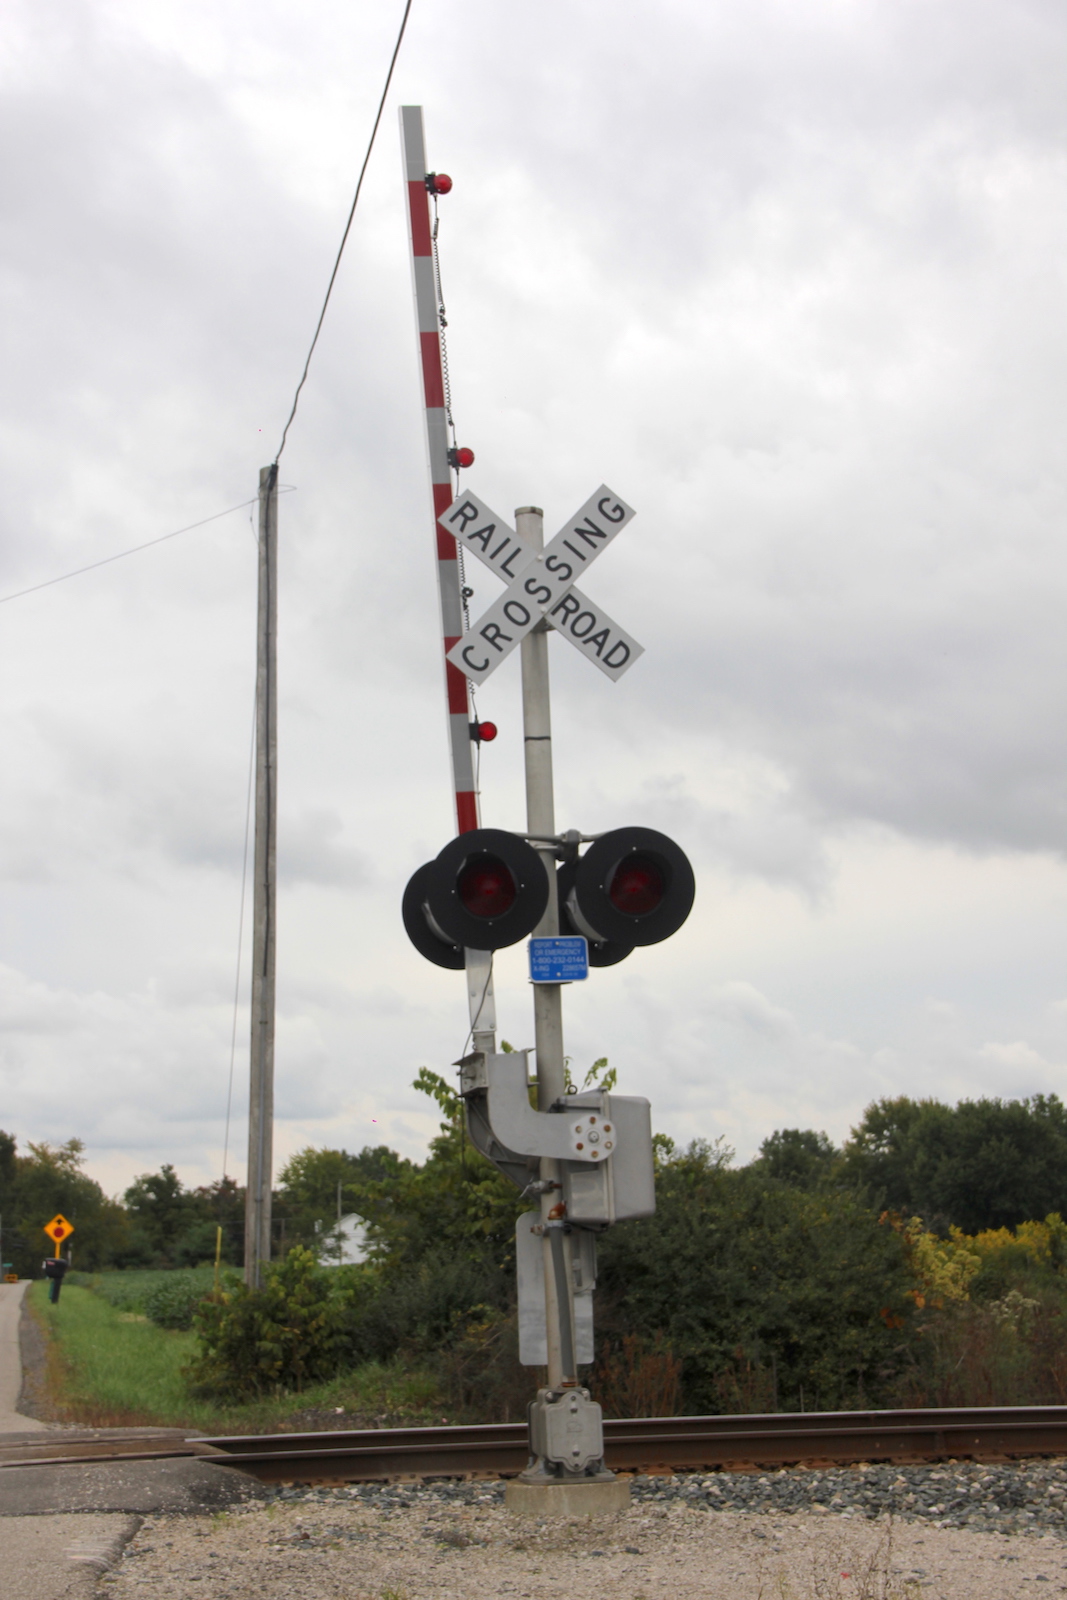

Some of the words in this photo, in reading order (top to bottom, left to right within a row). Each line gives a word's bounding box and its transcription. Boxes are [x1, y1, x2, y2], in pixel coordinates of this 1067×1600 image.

[449, 500, 522, 579] RAIL
[551, 593, 631, 669] ROAD
[461, 497, 626, 673] CROSSING
[532, 956, 585, 964] 1-800-232-0144
